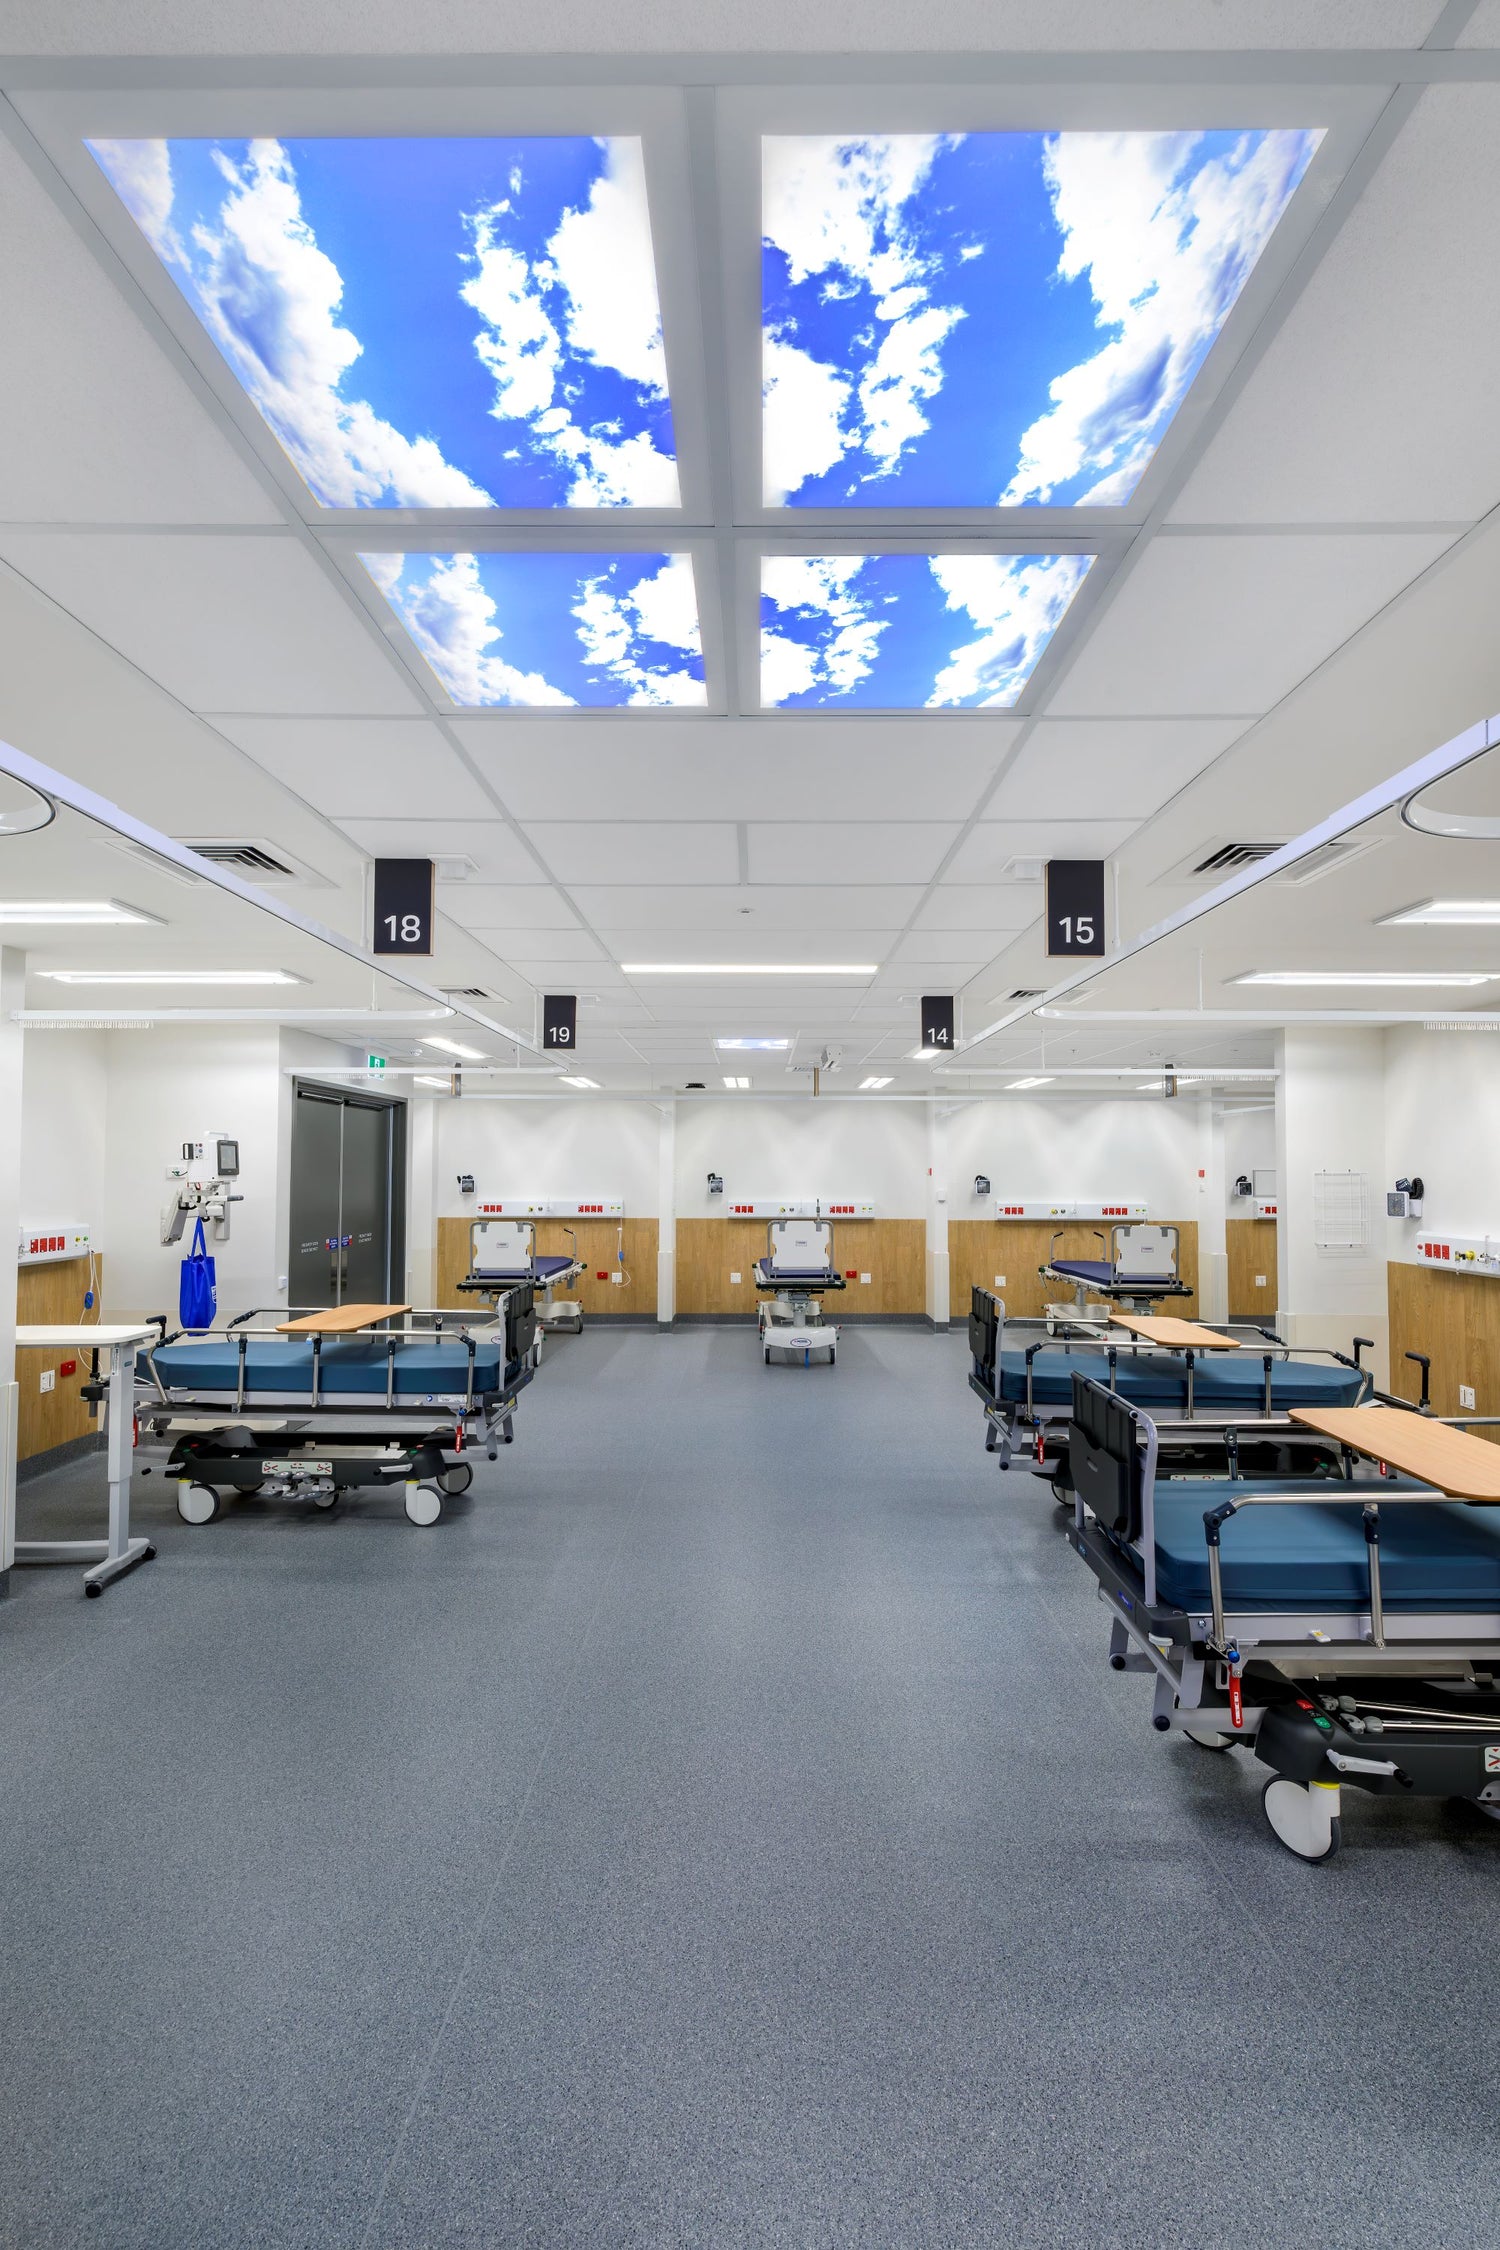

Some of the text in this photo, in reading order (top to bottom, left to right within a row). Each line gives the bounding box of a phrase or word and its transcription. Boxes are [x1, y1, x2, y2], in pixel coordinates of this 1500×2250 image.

[384, 914, 420, 942] 18
[1059, 916, 1094, 944] 15
[549, 1026, 570, 1042] 19
[927, 1027, 949, 1043] 14
